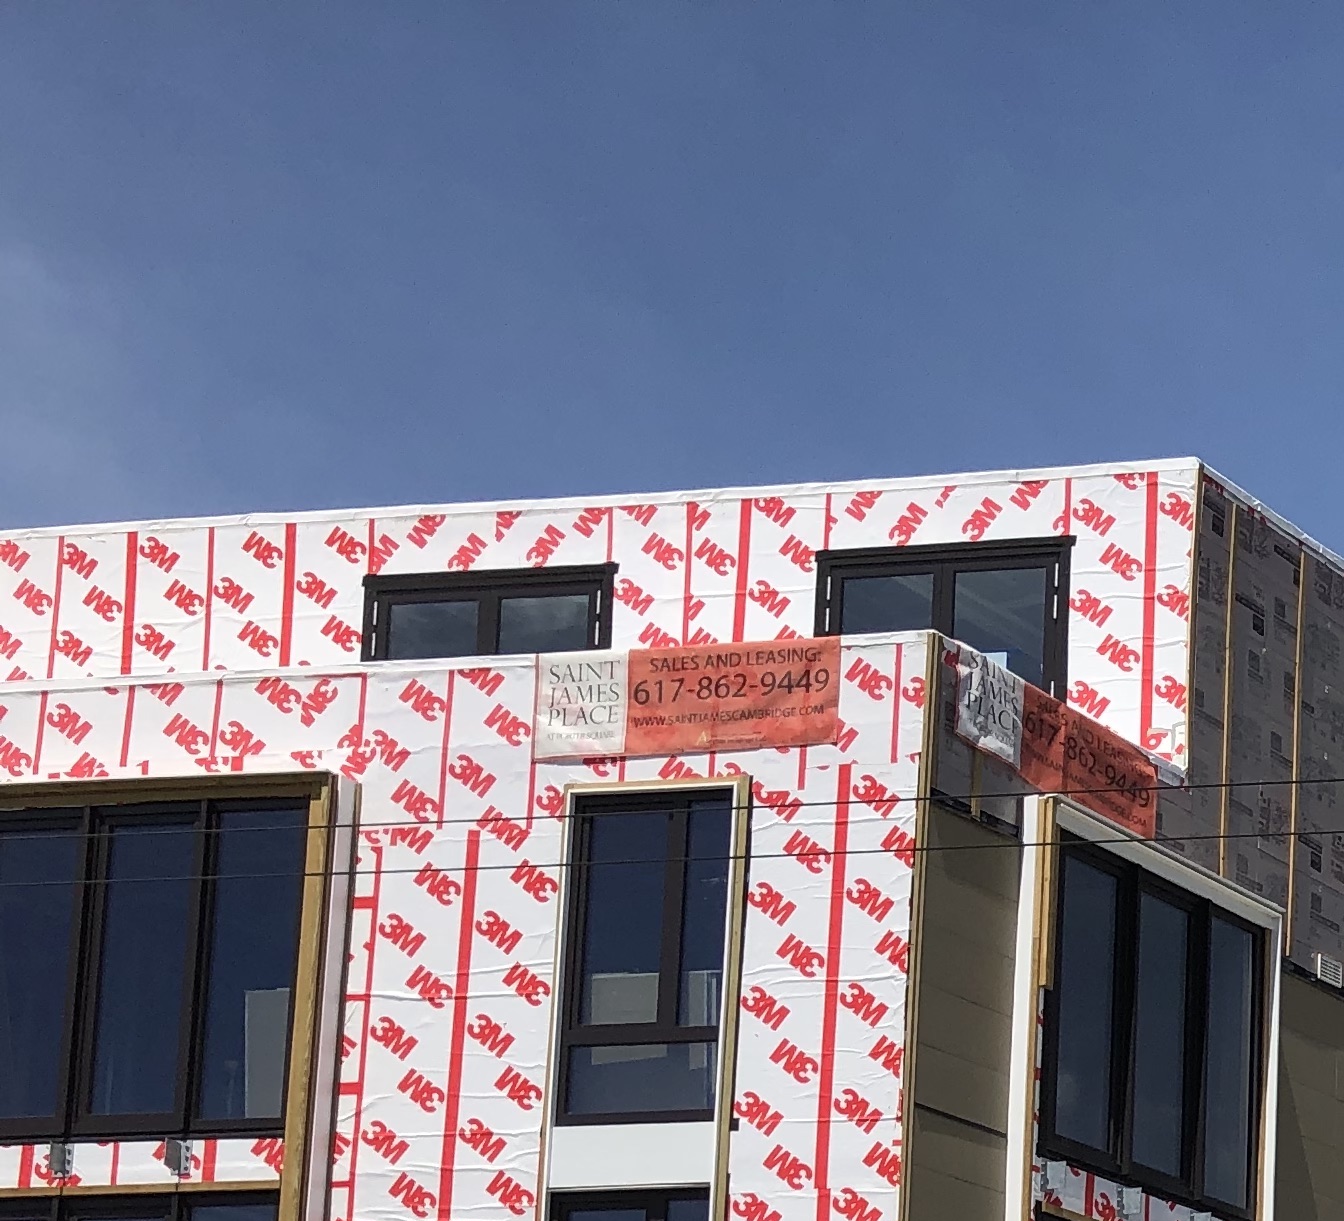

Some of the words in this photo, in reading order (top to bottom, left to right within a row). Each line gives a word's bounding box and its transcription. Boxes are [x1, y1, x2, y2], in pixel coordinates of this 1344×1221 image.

[888, 502, 928, 547] 3M
[961, 497, 1002, 543] 3M
[1071, 498, 1116, 536] 3M
[526, 524, 565, 568] 3M
[693, 538, 737, 576] 3M
[1099, 543, 1143, 581] 3M
[295, 572, 337, 609] 3M
[1067, 589, 1113, 627] 3M
[550, 660, 620, 684] SAINT
[650, 655, 699, 673] SALES
[704, 652, 741, 669] AND
[747, 647, 822, 666] LEASING:
[845, 658, 893, 700] 3M
[550, 682, 620, 708] JAMES
[633, 667, 830, 706] 617-862-9449
[46, 704, 91, 744] 3M
[163, 715, 210, 755] 3M
[485, 706, 532, 745] 3M
[548, 705, 619, 727] PLACE
[631, 704, 824, 728] WWW.SAINTJAMESCAMBRIDGE.COM
[447, 755, 495, 796] 3M
[851, 775, 898, 817] 3M
[511, 860, 559, 902] 3M
[747, 882, 796, 924] 3M
[377, 914, 425, 956] 3M
[474, 911, 522, 954] 3M
[777, 935, 826, 977] 3M
[838, 982, 888, 1026] 3M
[732, 1092, 783, 1136] 3M
[360, 1121, 409, 1163] 3M
[486, 1171, 535, 1215] 3M
